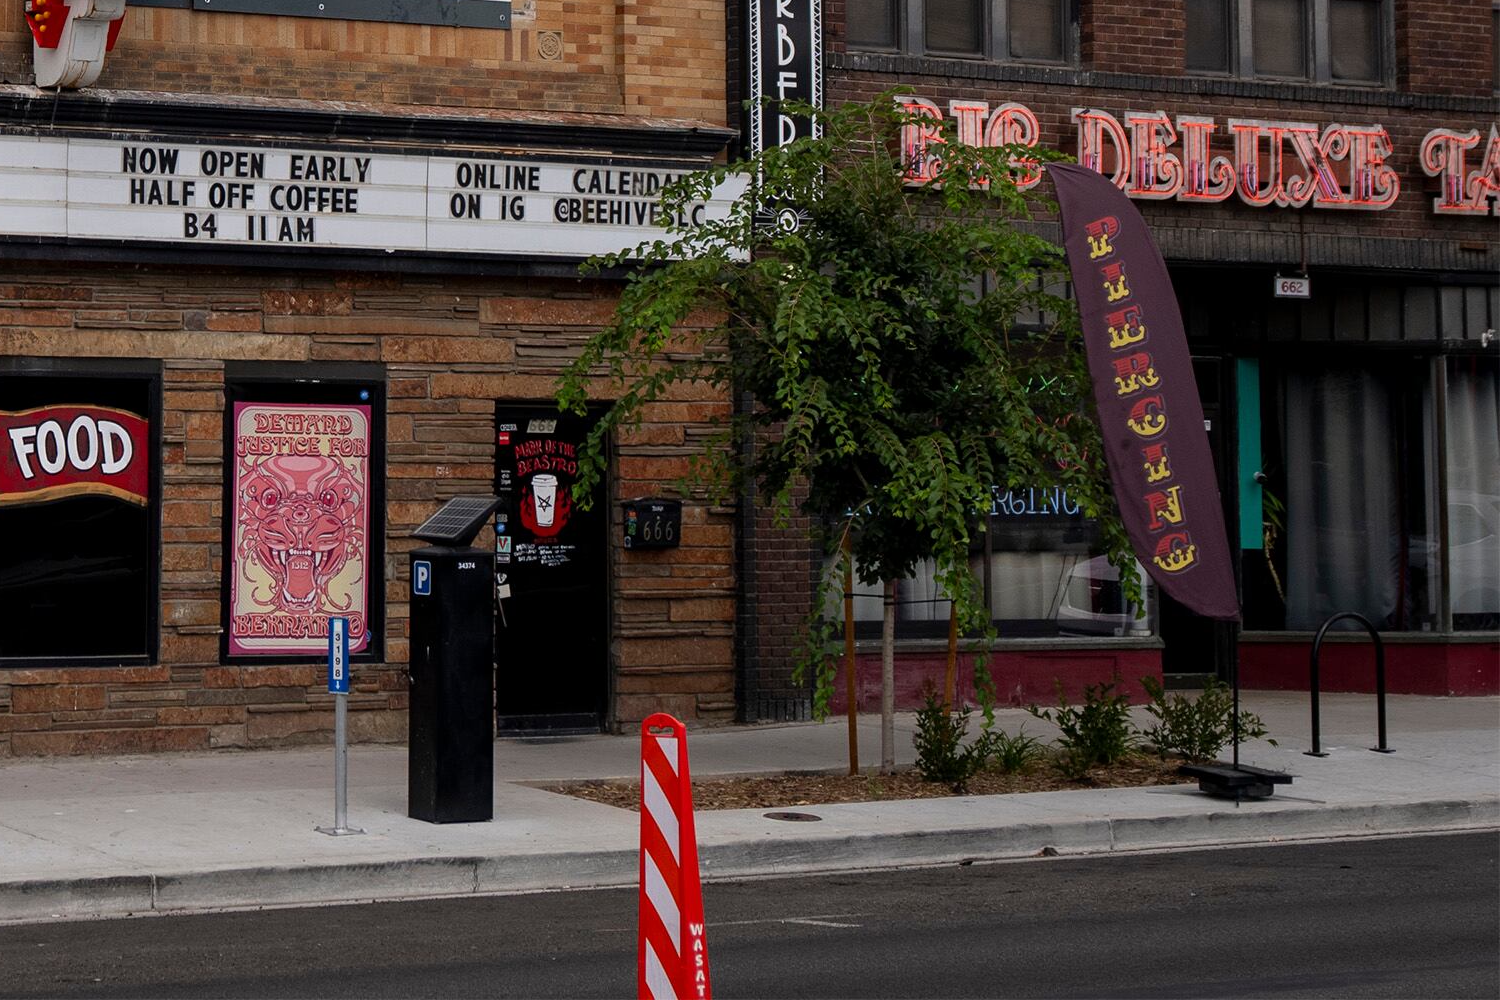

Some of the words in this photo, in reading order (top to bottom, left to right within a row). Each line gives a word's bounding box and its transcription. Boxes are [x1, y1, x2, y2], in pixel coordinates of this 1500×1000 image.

[123, 147, 179, 175] NOW
[201, 150, 264, 179] OPEN
[290, 155, 371, 183] EARLY
[1071, 107, 1400, 212] DELUXE
[457, 162, 540, 191] ONLINE
[131, 178, 195, 207] HALF
[209, 182, 255, 210] OFF
[270, 185, 358, 214] COFFEE
[450, 193, 481, 220] ON
[501, 196, 525, 221] IG
[184, 212, 217, 239] B4
[278, 217, 315, 243] AM
[1281, 280, 1303, 294] 662
[1083, 215, 1197, 574] PIERCING
[254, 413, 353, 435] DEMAND
[7, 413, 133, 479] FOOD
[237, 435, 322, 457] JUSTICE
[517, 455, 577, 476] BEASTRO
[643, 521, 673, 541] 666
[418, 566, 428, 589] P
[233, 614, 365, 640] BERNARO
[690, 923, 706, 997] WASAT
